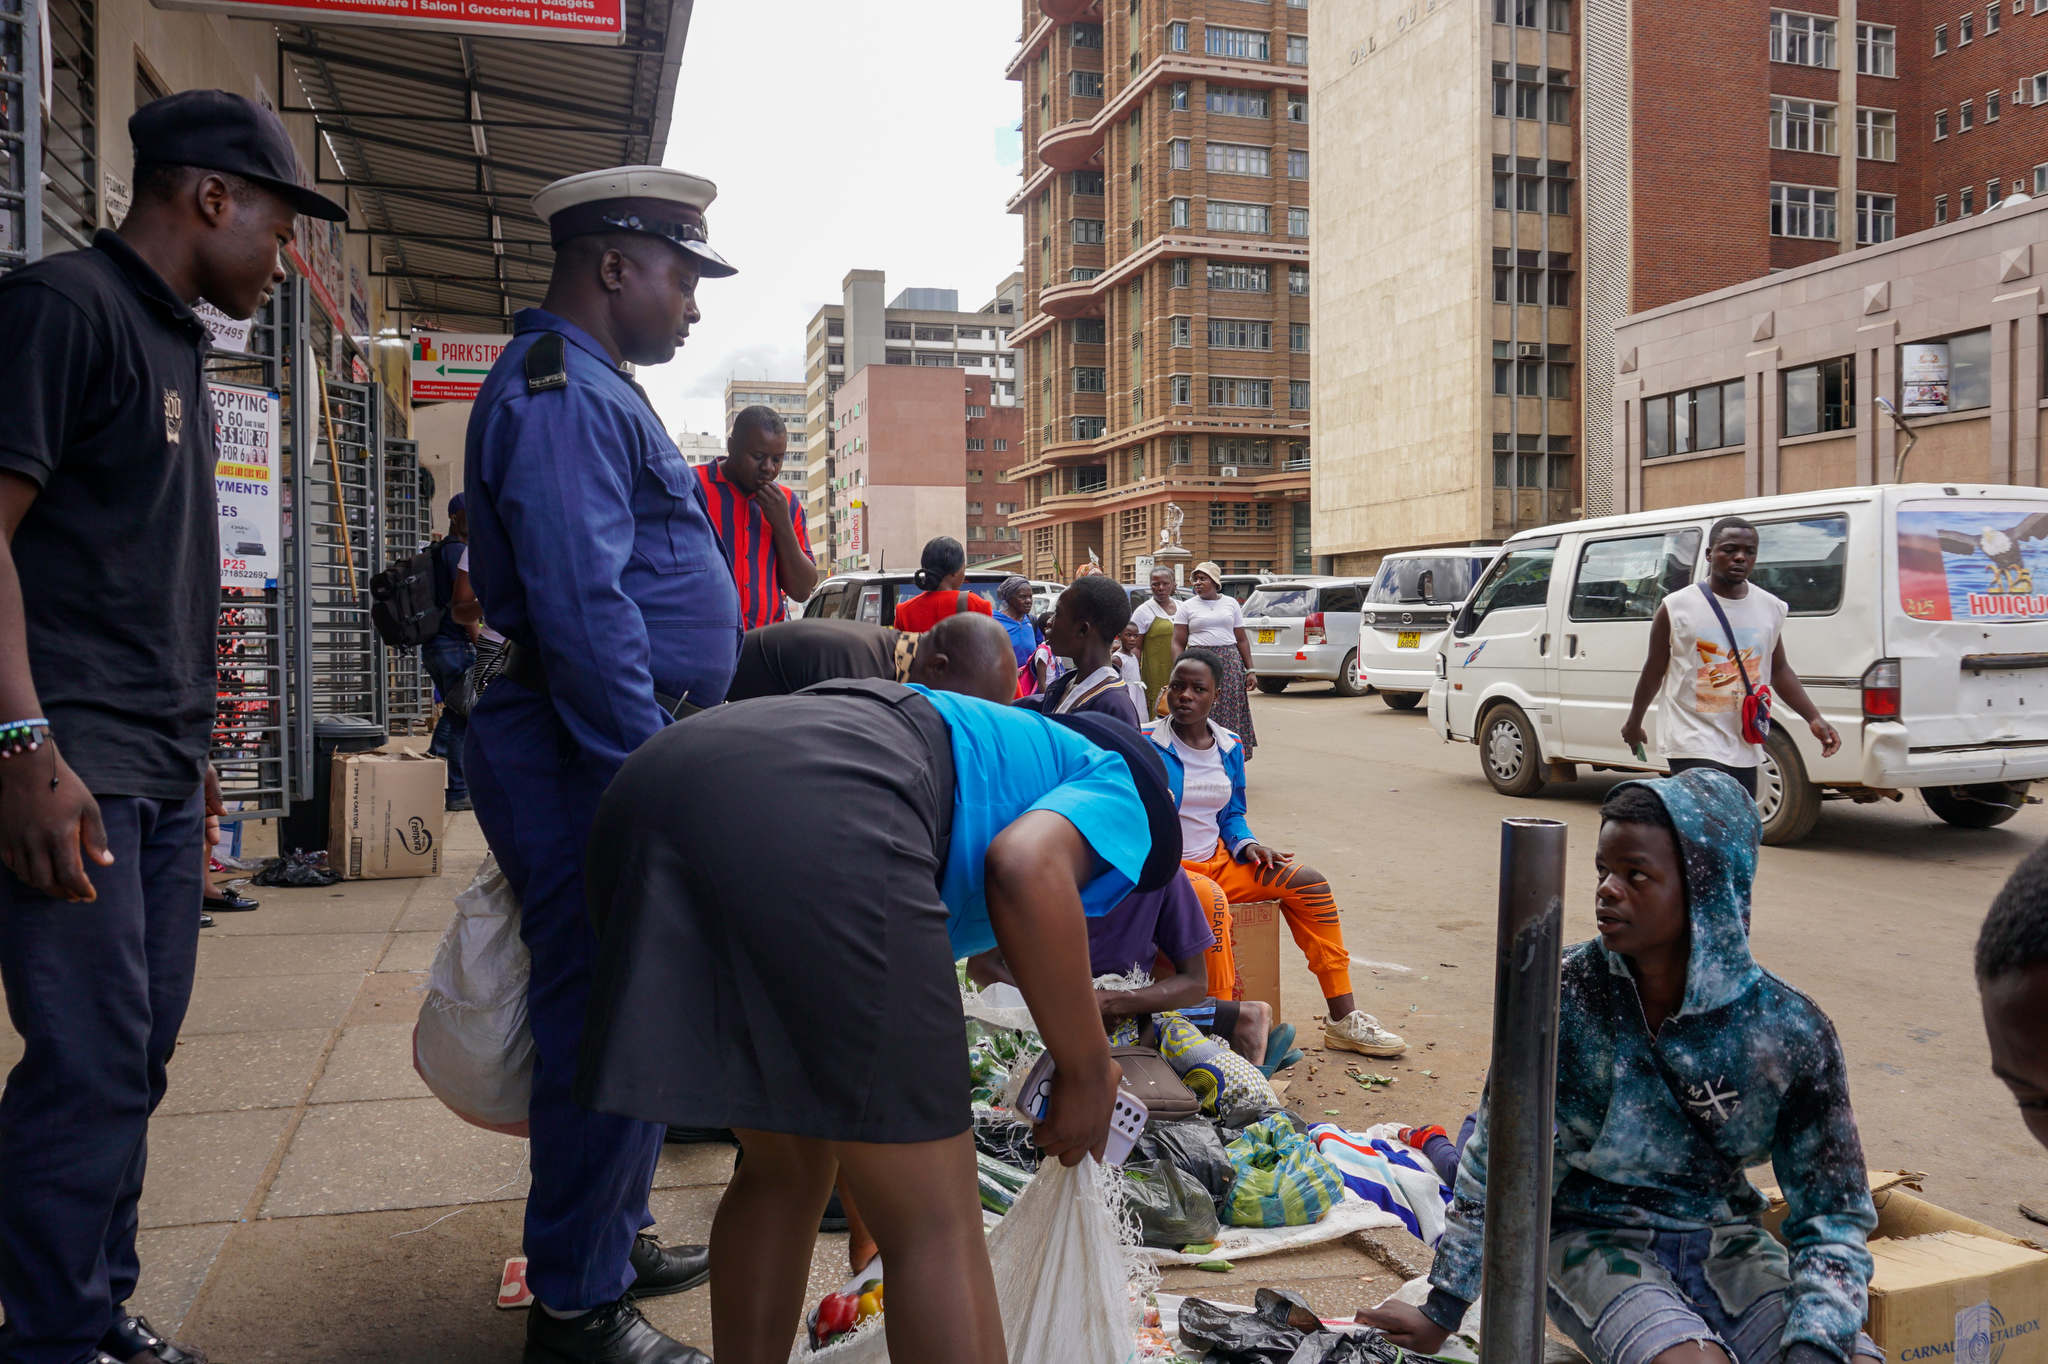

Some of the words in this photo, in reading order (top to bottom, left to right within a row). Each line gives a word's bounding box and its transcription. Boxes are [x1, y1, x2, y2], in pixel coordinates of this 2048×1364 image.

[420, 0, 457, 12] Salon
[468, 3, 531, 18] Groceries
[542, 9, 615, 25] Plasticware
[228, 411, 243, 427] 60
[256, 431, 267, 447] 30
[223, 444, 238, 461] FOR
[223, 559, 247, 570] P25
[1969, 594, 2048, 616] HUNGW
[1989, 1319, 2040, 1345] ETALBOX
